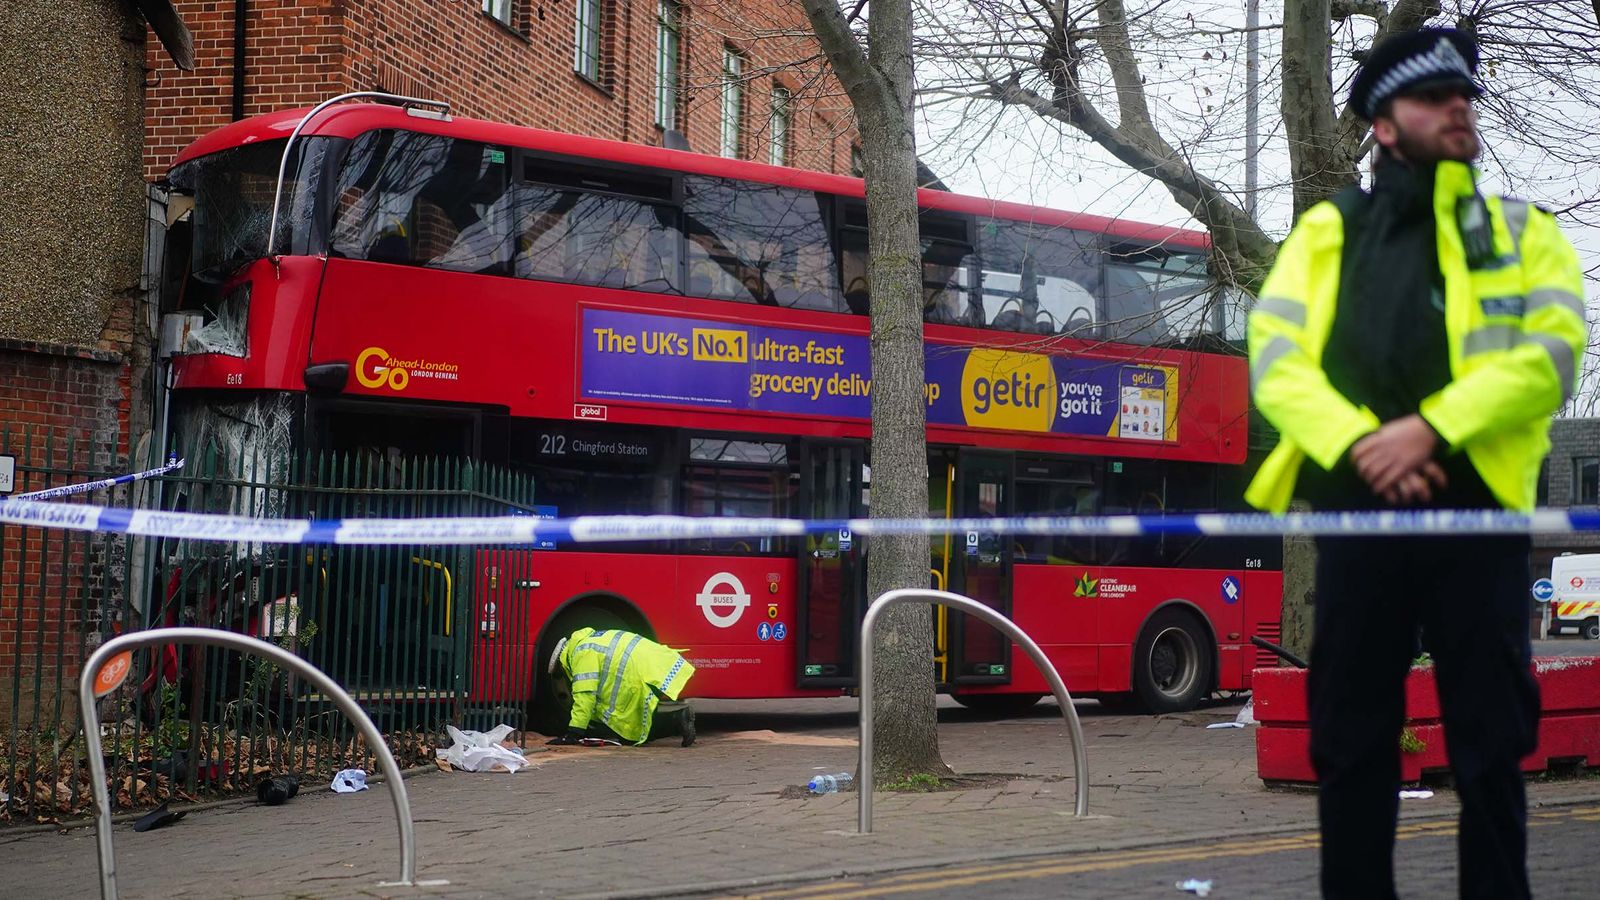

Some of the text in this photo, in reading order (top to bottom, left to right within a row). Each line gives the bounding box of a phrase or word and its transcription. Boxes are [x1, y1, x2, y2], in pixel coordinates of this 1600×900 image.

[593, 327, 844, 366] The UK's No.1 ultra-fast
[355, 346, 409, 391] Go
[385, 357, 458, 372] Ahead-London
[411, 369, 458, 380] LONDON GENERAL
[1132, 372, 1155, 386] getir
[749, 373, 823, 401] grocery
[826, 373, 872, 397] deliv
[973, 371, 1045, 414] getir
[1061, 381, 1103, 398] you've
[580, 407, 601, 417] global
[1061, 395, 1102, 418] got it
[540, 433, 648, 456] 212 Chingford Station
[1245, 558, 1262, 568] Ee18
[713, 596, 734, 604] BUSES
